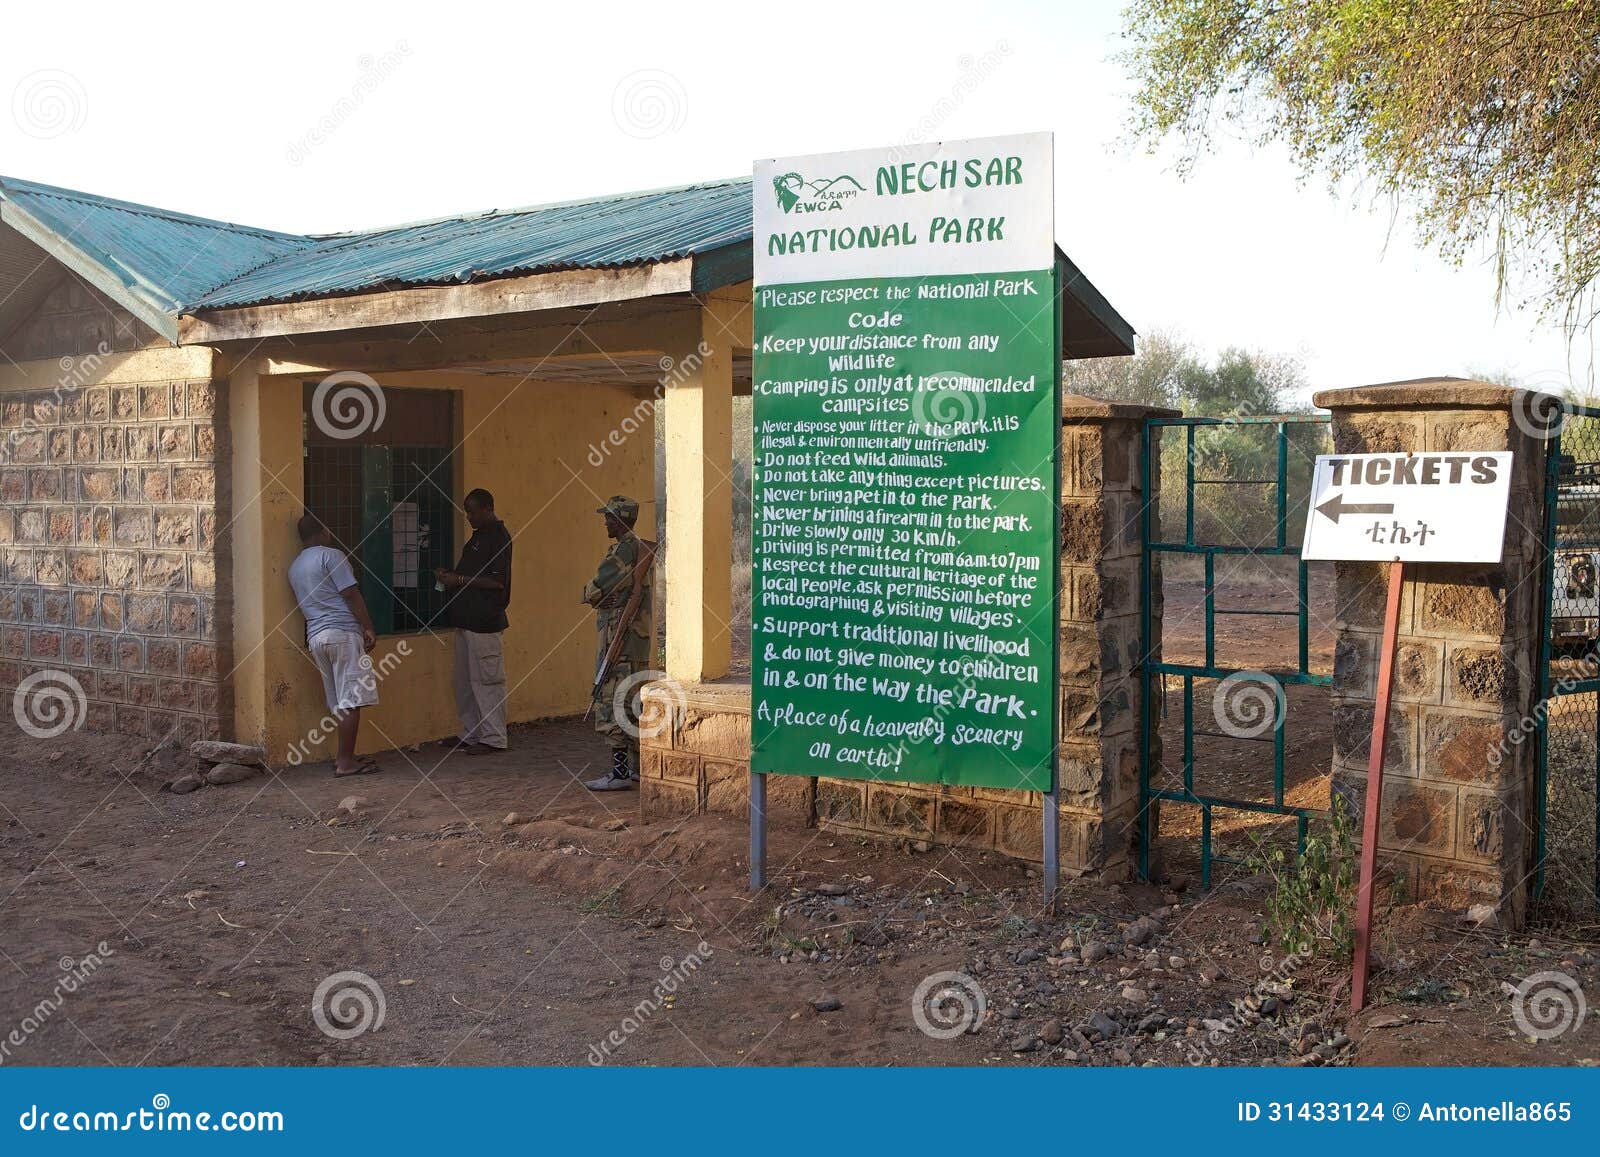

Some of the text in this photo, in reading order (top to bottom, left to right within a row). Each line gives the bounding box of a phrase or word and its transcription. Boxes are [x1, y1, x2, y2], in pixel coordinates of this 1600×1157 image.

[795, 200, 842, 213] EWCA
[768, 217, 1005, 256] NATIONAL PARK
[762, 278, 1038, 308] Please respect the National Park
[848, 311, 903, 328] Code
[762, 335, 805, 353] Keep
[922, 333, 961, 350] from
[968, 334, 999, 352] any
[761, 378, 828, 397] Camping
[854, 374, 891, 396] only
[894, 374, 913, 392] at
[918, 375, 1035, 393] recommended
[762, 420, 793, 434] Never
[793, 420, 837, 434] dispose
[839, 420, 867, 434] your
[869, 419, 905, 433] litter
[907, 420, 919, 435] in
[925, 421, 952, 436] the
[798, 435, 807, 447] &
[914, 438, 989, 453] unfriendly.
[764, 452, 784, 467] Do
[787, 452, 812, 466] not
[813, 450, 851, 466] feed
[763, 470, 781, 483] Do
[784, 470, 809, 482] not
[811, 469, 845, 483] take
[914, 475, 964, 490] except
[1329, 457, 1498, 486] TICKETS
[763, 488, 807, 503] Never
[920, 492, 949, 507] the
[762, 505, 811, 521] Never
[812, 507, 864, 524] brining
[963, 514, 991, 530] the
[762, 522, 802, 538] Drive
[852, 527, 885, 544] only
[891, 529, 910, 543] 30
[1365, 520, 1435, 546] ቲኬት
[762, 540, 813, 557] Driving
[816, 541, 829, 556] is
[831, 543, 910, 562] permitted
[915, 548, 954, 567] from
[762, 557, 1038, 590] Respect the cultural heritage of the
[762, 575, 798, 592] local
[975, 589, 1032, 608] before
[872, 599, 886, 617] &
[762, 616, 1030, 657] Support traditional livelihood
[763, 643, 1039, 684] & do not give money to children
[763, 667, 780, 686] in
[783, 670, 801, 689] &
[803, 672, 828, 690] on
[832, 673, 867, 692] the
[915, 682, 953, 705] the
[757, 700, 772, 721] A
[773, 702, 826, 727] place
[829, 709, 850, 735] of
[808, 742, 831, 759] on
